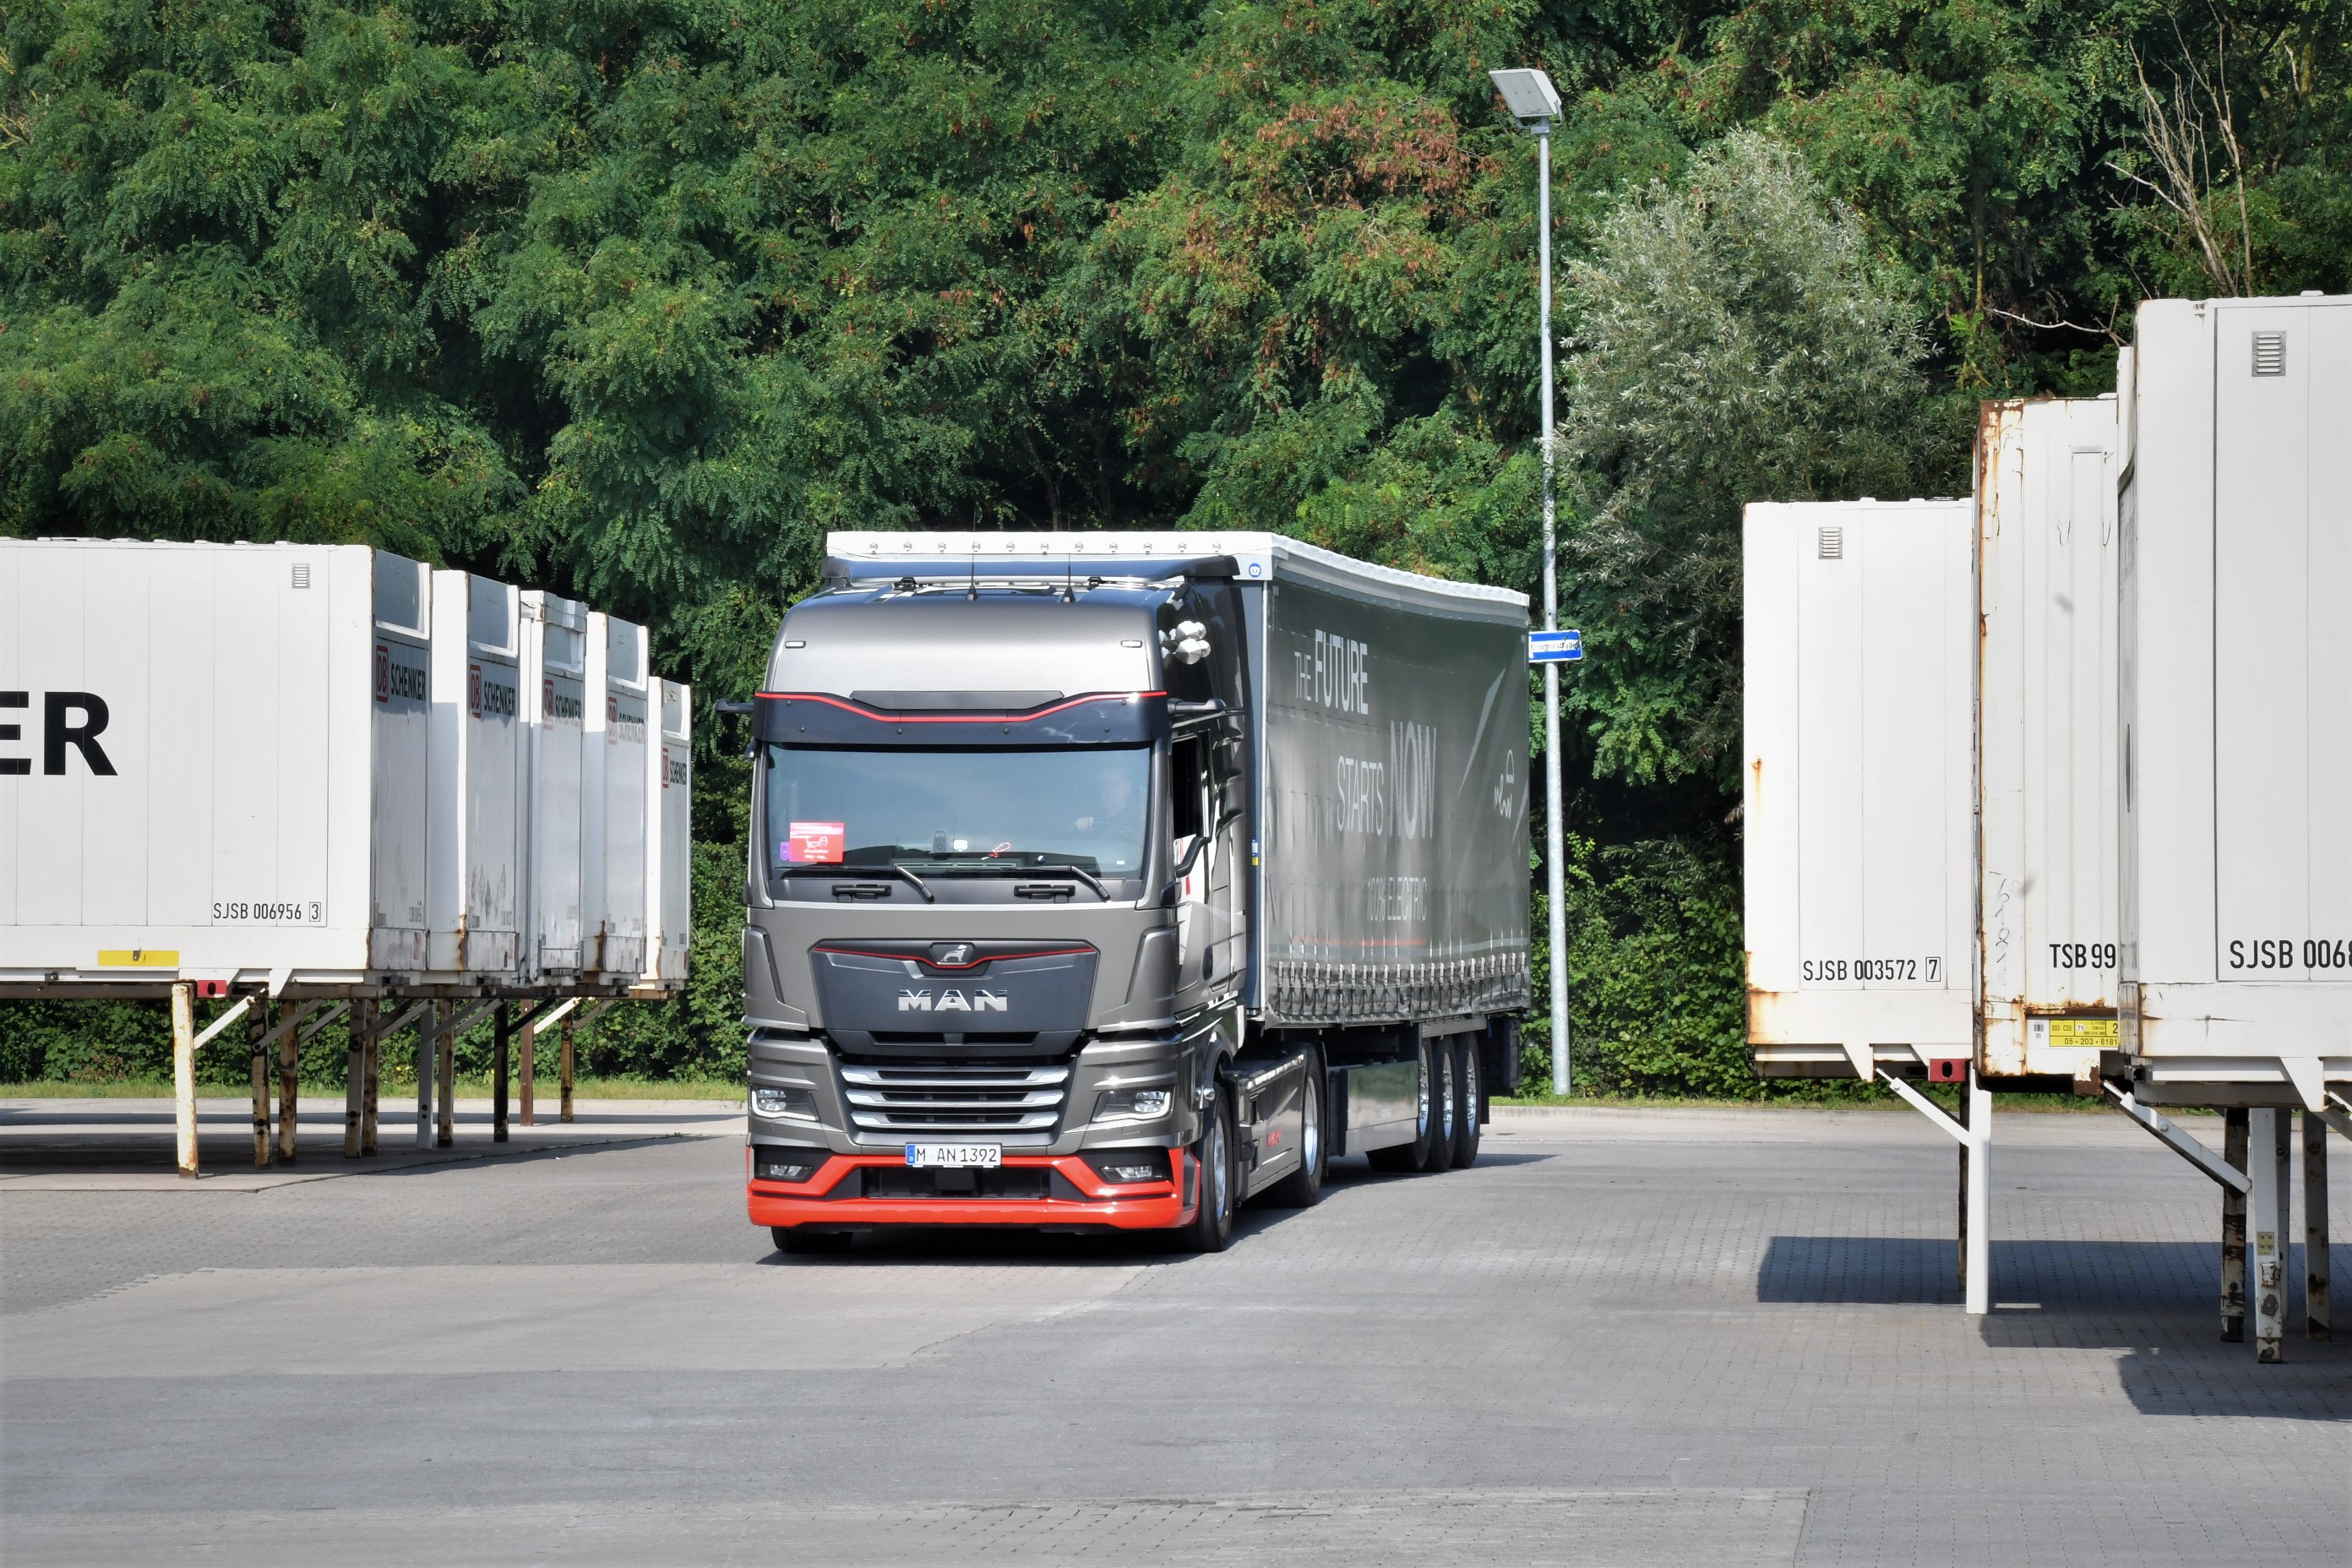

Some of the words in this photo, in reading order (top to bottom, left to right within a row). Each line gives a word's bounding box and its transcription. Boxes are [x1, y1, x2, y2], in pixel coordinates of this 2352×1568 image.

[377, 654, 388, 694] DB
[390, 662, 427, 702] SCHENKER
[1294, 651, 1311, 701] THE
[1315, 629, 1369, 715] FUTURE
[471, 672, 481, 710] DB
[484, 680, 516, 716] SCHENKER
[1337, 755, 1385, 836] STARTS
[1390, 721, 1437, 840] NOW
[213, 902, 248, 919] SJSB
[253, 902, 302, 920] 006956
[311, 903, 319, 920] 3
[1387, 876, 1428, 921] ELECTRIC
[2049, 943, 2087, 969] TSB
[2091, 943, 2116, 969] 99
[2230, 939, 2293, 969] SJSB
[1803, 960, 1848, 981] SJSB
[1854, 959, 1917, 981] 003572
[1928, 959, 1938, 980] 7
[898, 989, 1008, 1011] MAN
[2080, 1037, 2093, 1046] 203
[2100, 1037, 2118, 1046] 6181
[916, 1147, 926, 1162] M
[937, 1147, 956, 1162] AN
[960, 1147, 997, 1162] 1392
